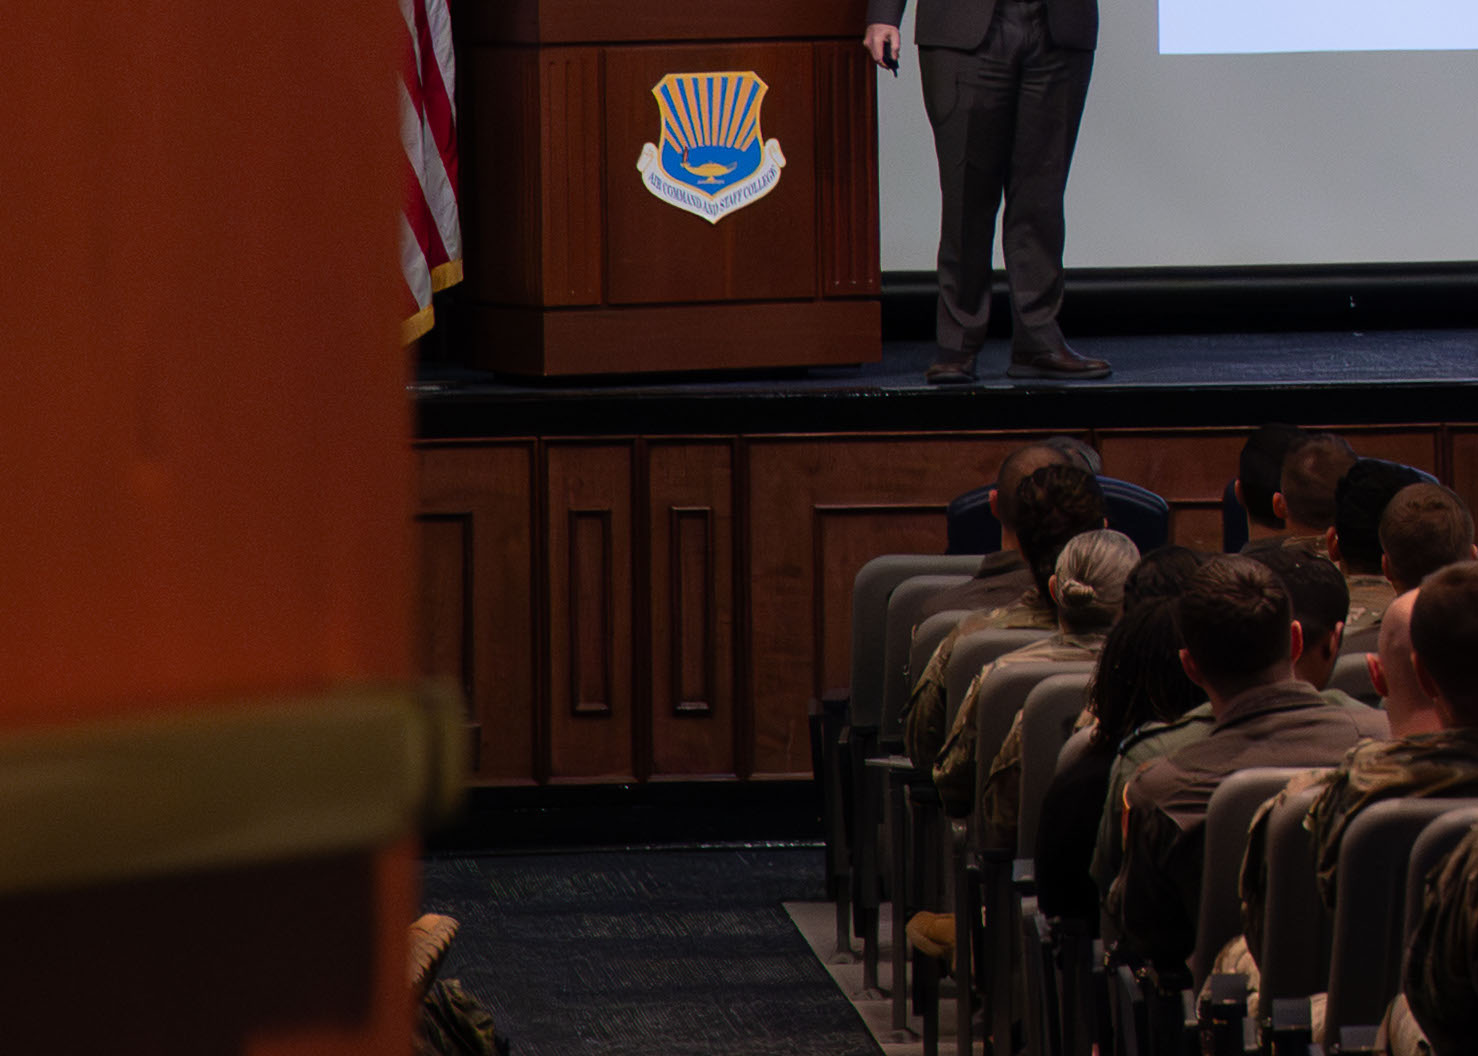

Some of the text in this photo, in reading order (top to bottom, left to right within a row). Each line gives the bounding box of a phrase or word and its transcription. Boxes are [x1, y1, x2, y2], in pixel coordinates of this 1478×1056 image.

[649, 166, 777, 217] AIR COMMAND AND STAFF COLLEGE
